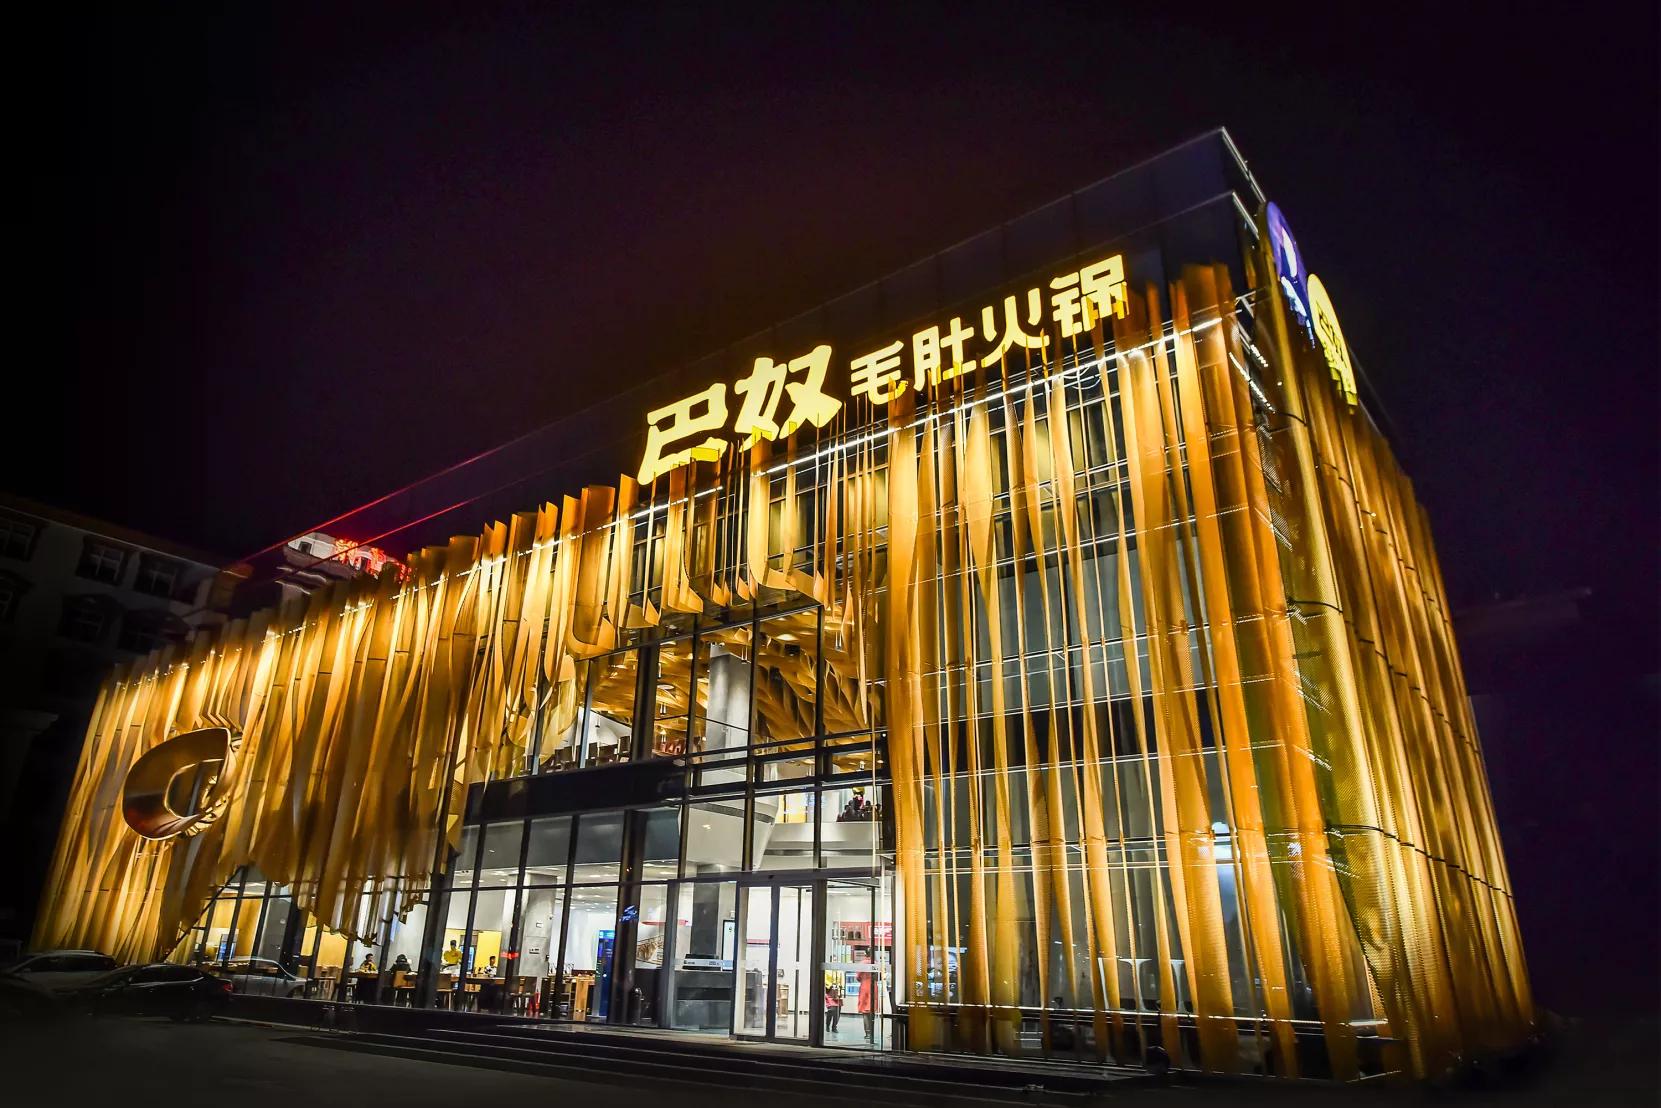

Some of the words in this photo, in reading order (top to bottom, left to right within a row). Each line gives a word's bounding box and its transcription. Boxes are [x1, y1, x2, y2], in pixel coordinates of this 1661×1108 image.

[637, 345, 843, 485] 巴奴
[850, 254, 1129, 405] 毛肚火锅
